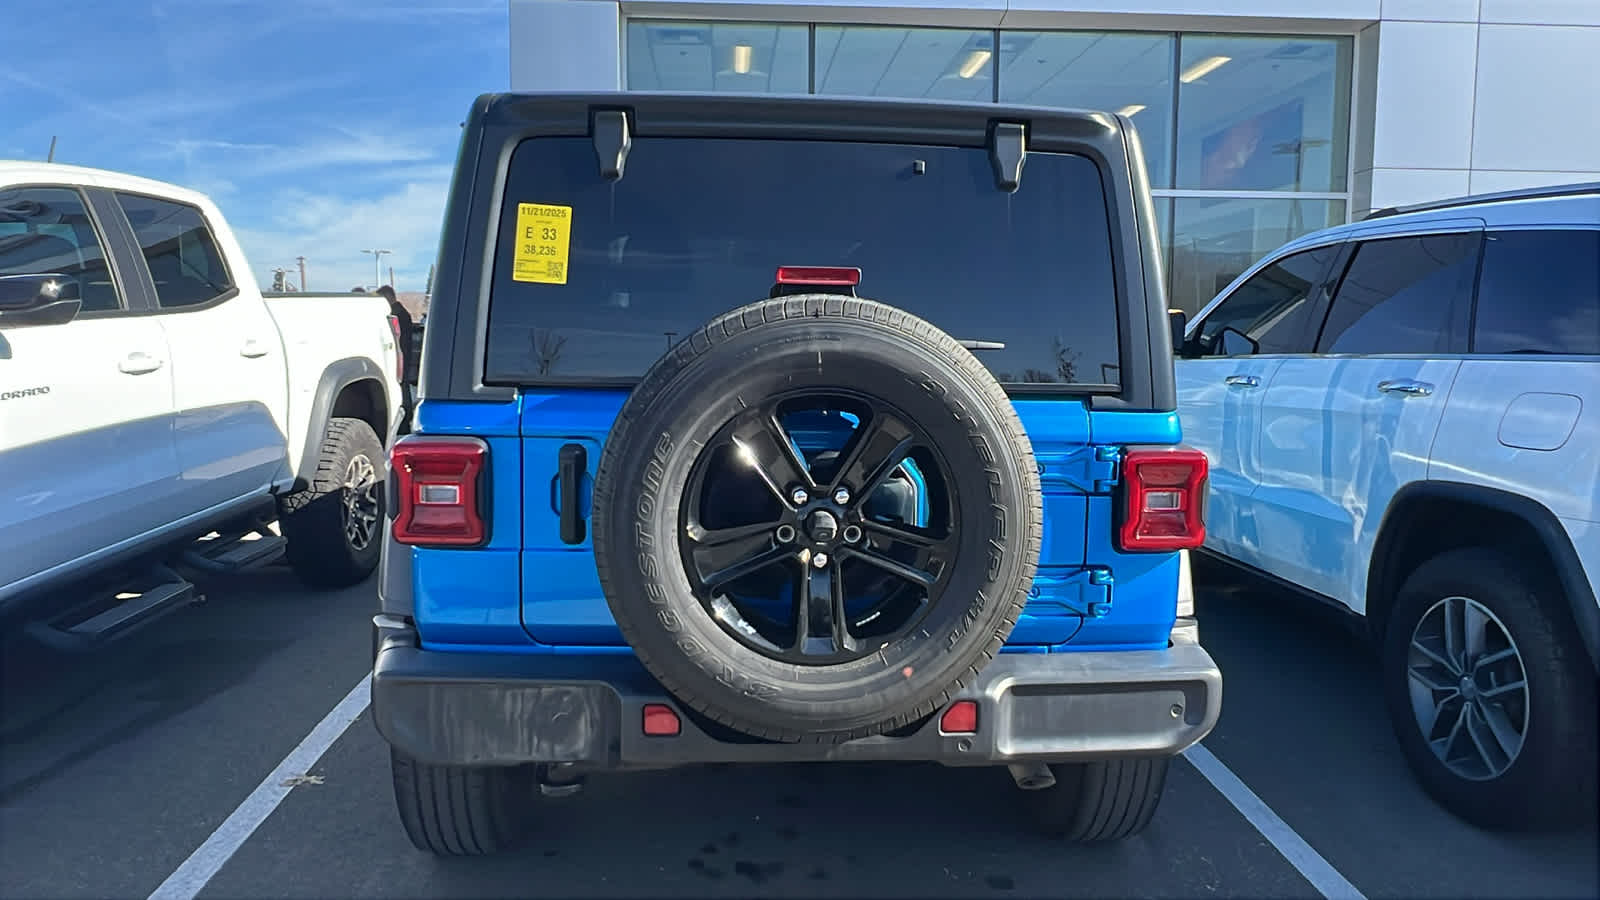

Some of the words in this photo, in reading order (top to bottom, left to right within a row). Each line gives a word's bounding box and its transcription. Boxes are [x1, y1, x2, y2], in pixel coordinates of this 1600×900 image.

[521, 207, 567, 218] 11/21/2025
[526, 226, 533, 239] E
[542, 227, 557, 241] 33
